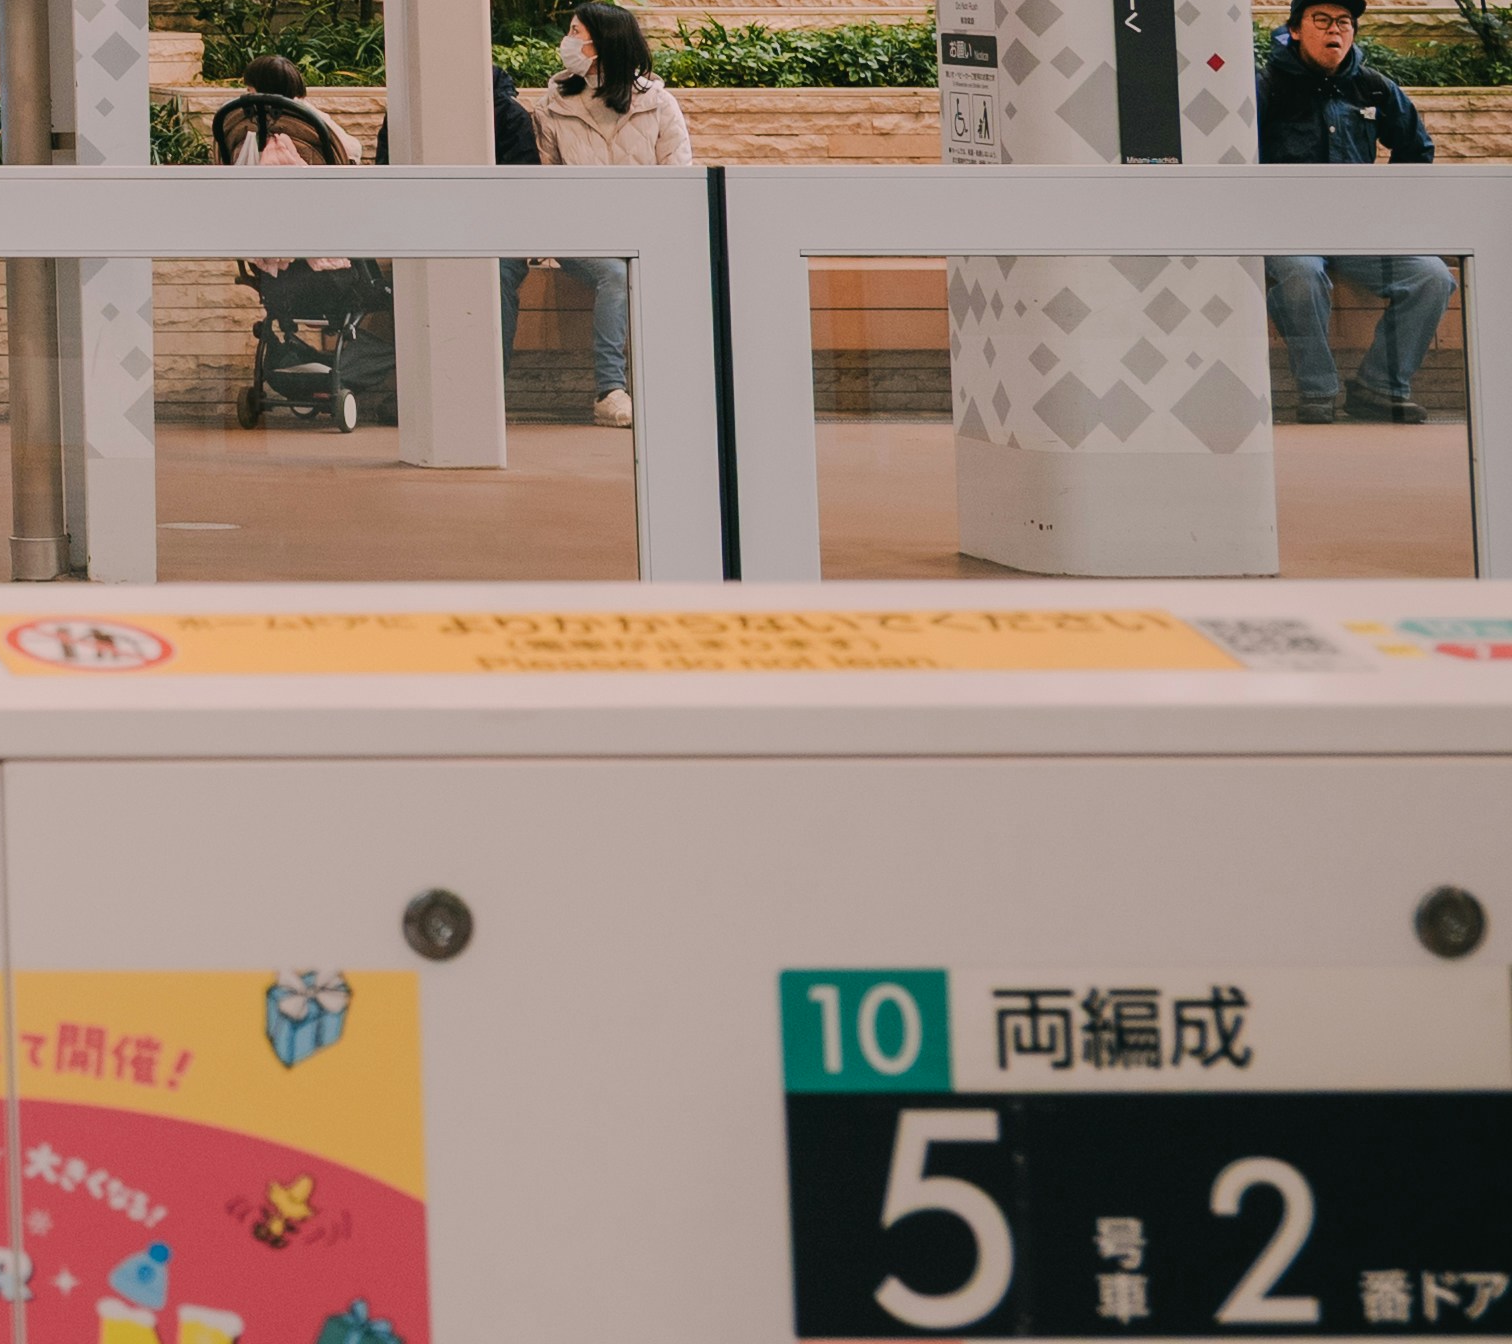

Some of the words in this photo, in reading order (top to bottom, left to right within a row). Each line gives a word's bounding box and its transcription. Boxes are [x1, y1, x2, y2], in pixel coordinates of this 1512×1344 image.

[809, 983, 922, 1074] 10
[992, 986, 1252, 1071] 両編成
[875, 1109, 1014, 1329] 5
[1094, 1216, 1149, 1322] 号車
[1210, 1157, 1320, 1324] 2
[1360, 1269, 1510, 1323] 番ドア
